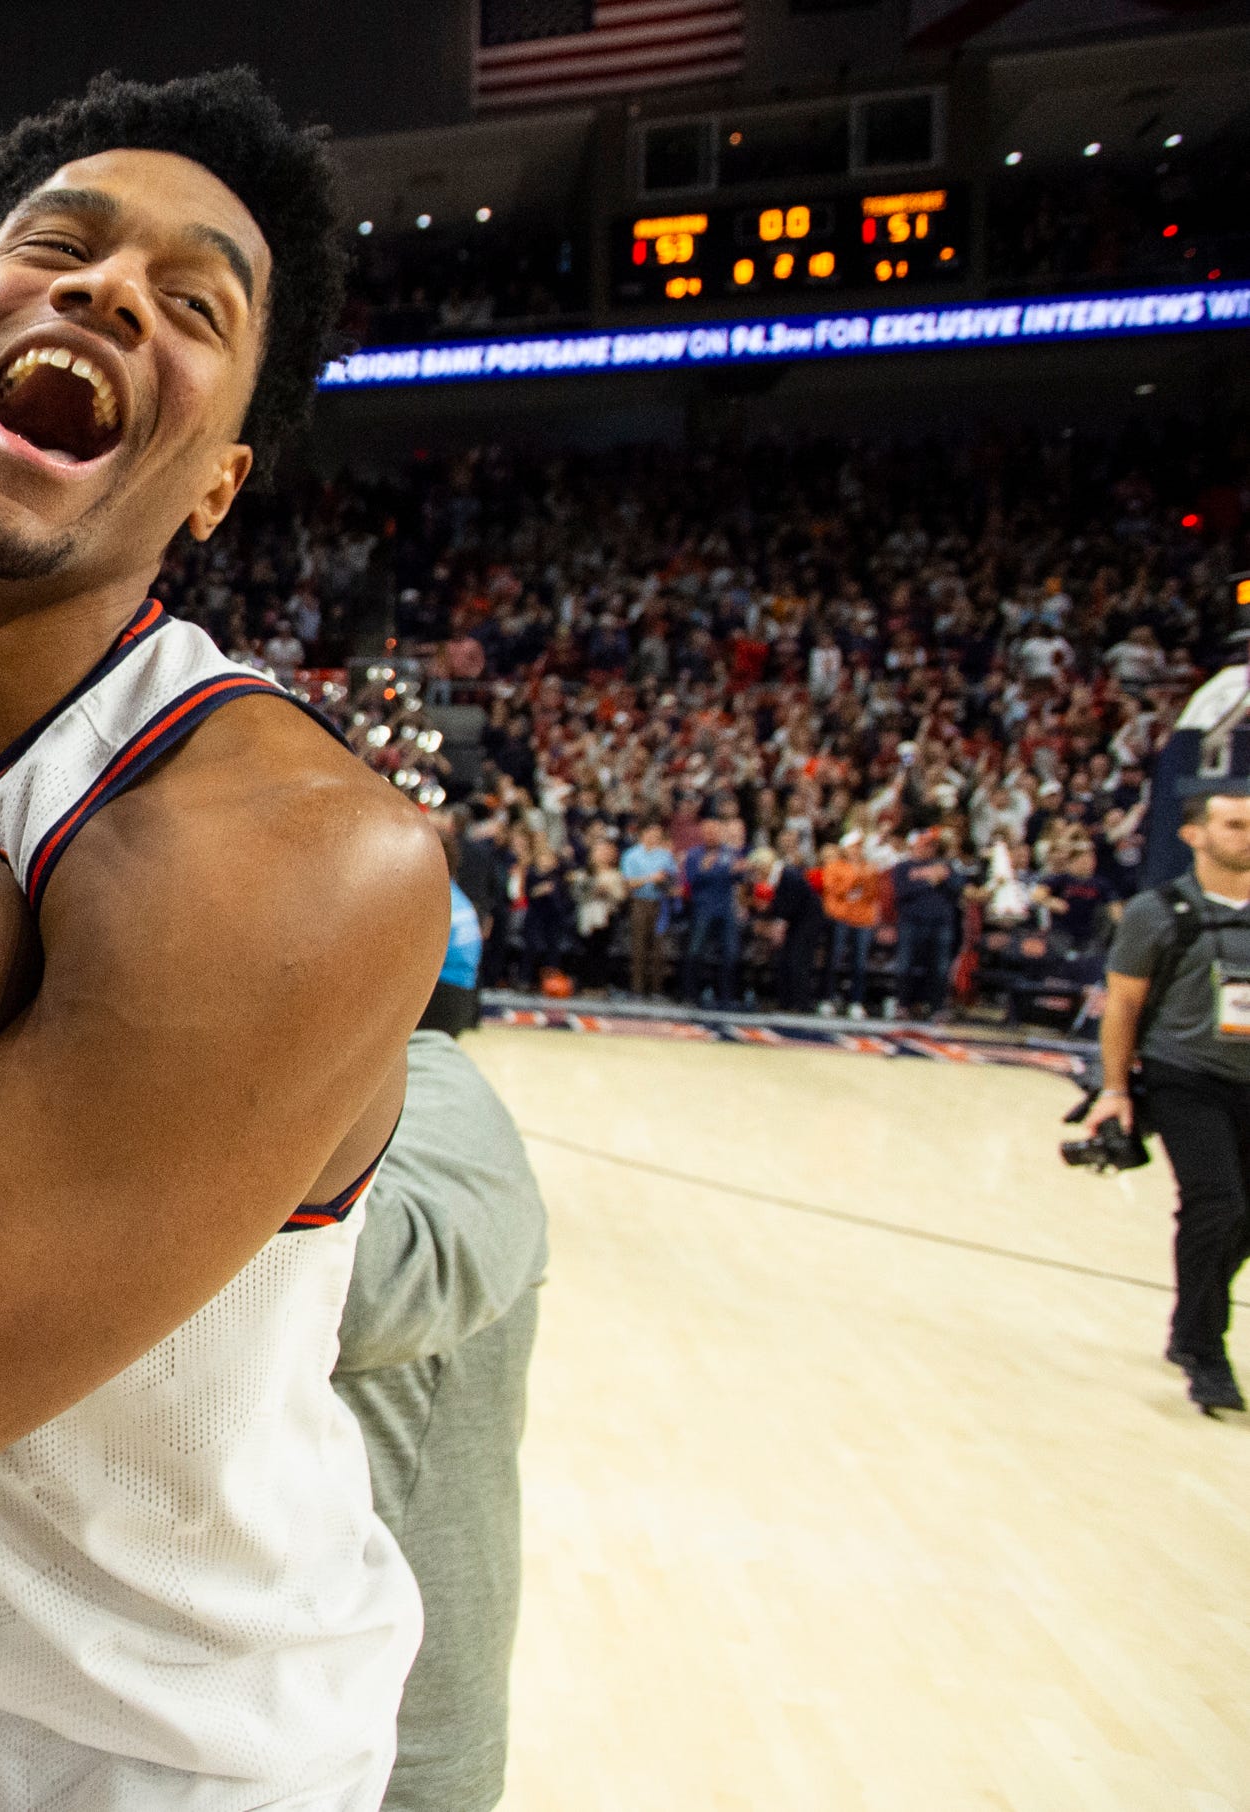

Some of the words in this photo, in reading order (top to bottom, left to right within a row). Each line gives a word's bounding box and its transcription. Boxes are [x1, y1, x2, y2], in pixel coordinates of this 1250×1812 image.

[484, 336, 610, 373] POSTGAME
[611, 331, 688, 364] SHOW
[687, 329, 727, 358] ON
[814, 317, 869, 348] FOR
[871, 306, 1020, 345] EXCLUSIVE
[1021, 291, 1205, 335] INTERVIEWS
